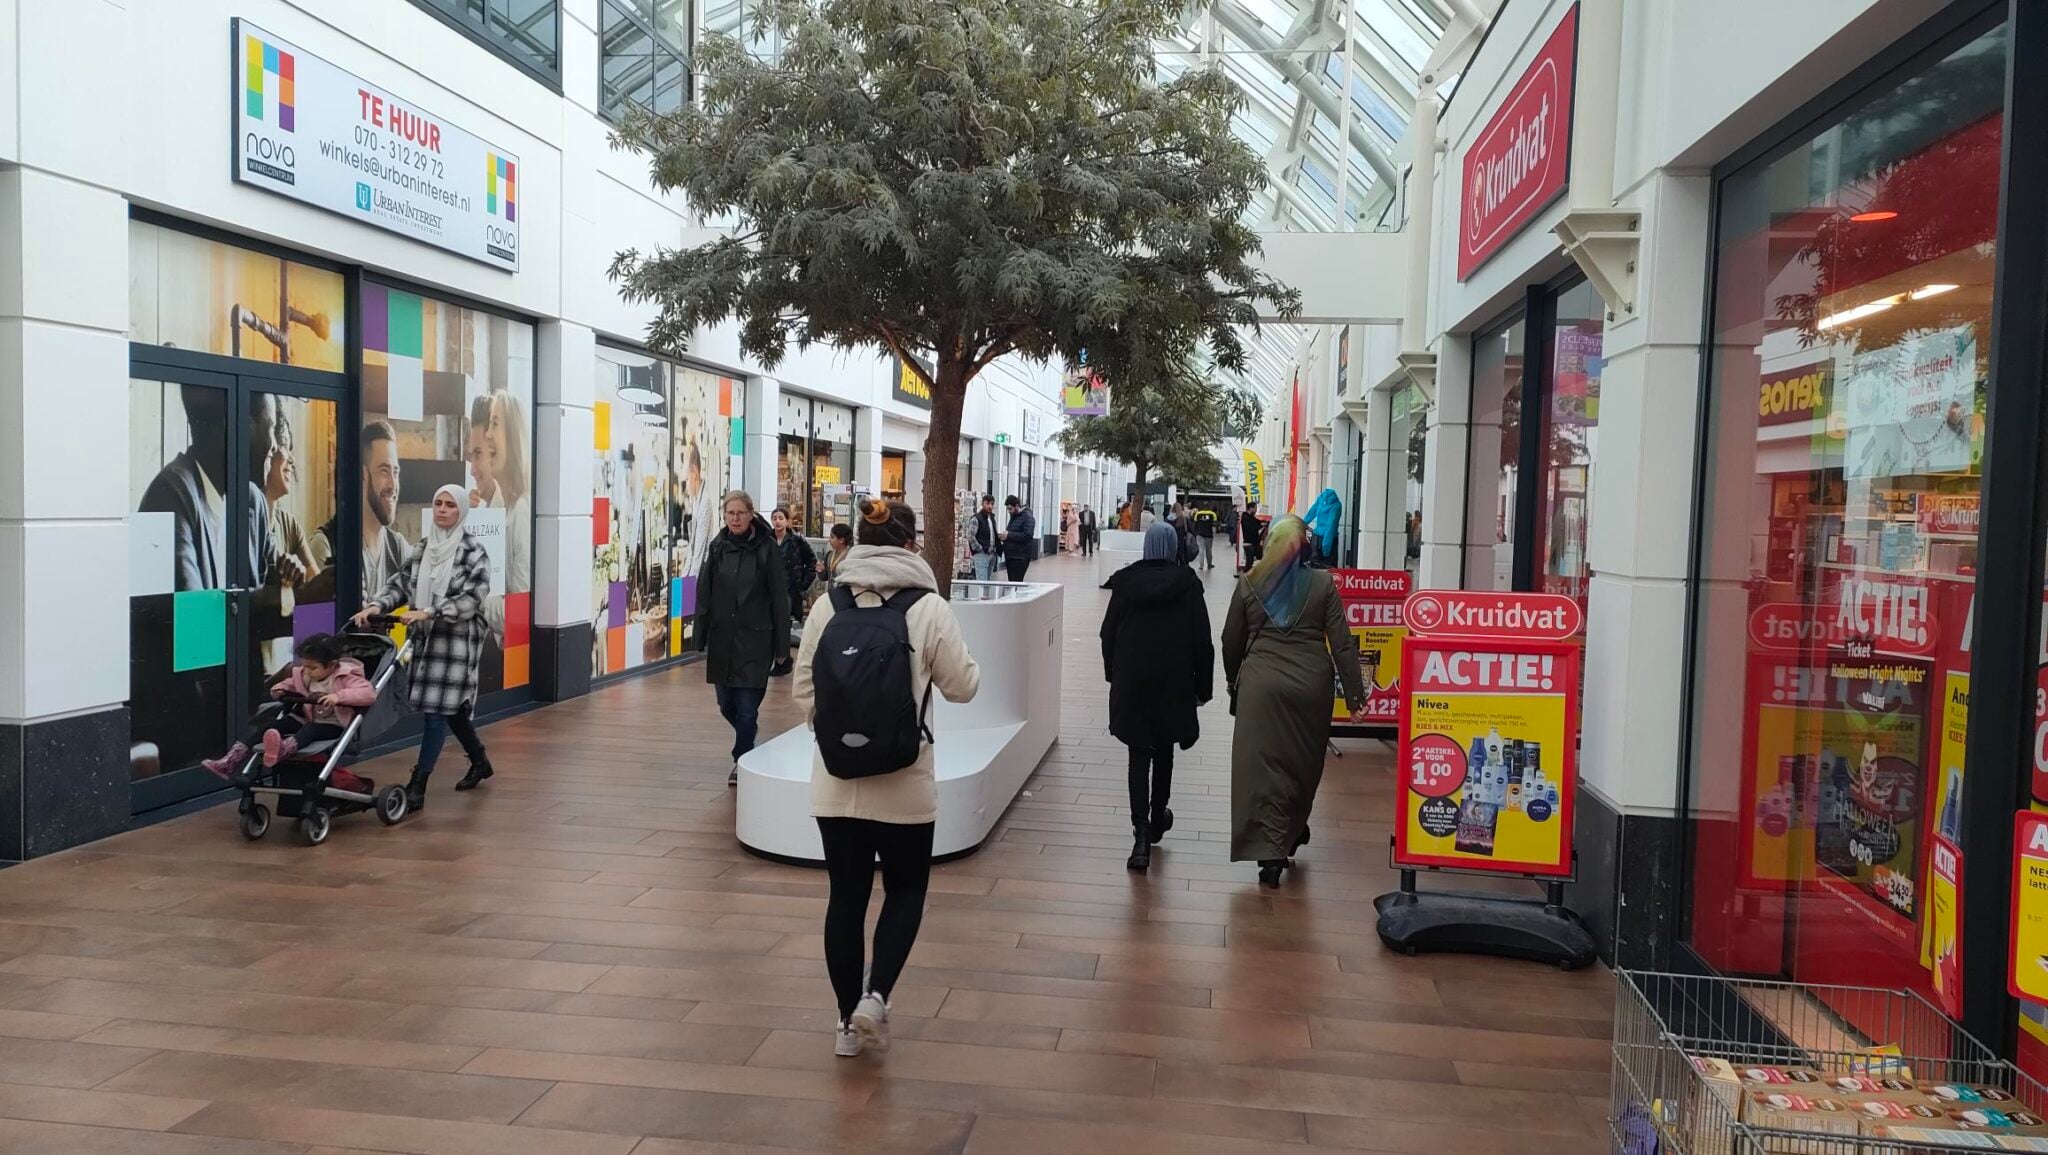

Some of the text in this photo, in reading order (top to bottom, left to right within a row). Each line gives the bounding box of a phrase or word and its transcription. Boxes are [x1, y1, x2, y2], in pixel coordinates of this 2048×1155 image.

[358, 88, 441, 154] TE HUUR
[247, 132, 294, 169] nova
[354, 125, 377, 151] 070
[389, 140, 410, 166] 312
[414, 151, 427, 172] 29
[431, 158, 444, 180] 72
[1485, 91, 1549, 218] Kruidvat
[320, 140, 471, 213] winkels@urbaninterest.nl
[487, 225, 515, 249] nova
[1345, 575, 1404, 591] Kruidvat
[1345, 603, 1402, 624] CTIE!
[1447, 600, 1567, 630] Kruidvat
[1836, 578, 1929, 646] ACTIE!
[1848, 642, 1871, 658] Ticket
[1420, 651, 1553, 690] ACTIE!
[1831, 663, 1868, 680] Halloween
[1869, 664, 1893, 684] Fright
[1417, 699, 1449, 710] Nivea
[1949, 730, 1963, 744] KIES
[1425, 747, 1456, 755] ARTIKEL
[1412, 761, 1451, 786] 1.00
[1423, 805, 1445, 814] KANS
